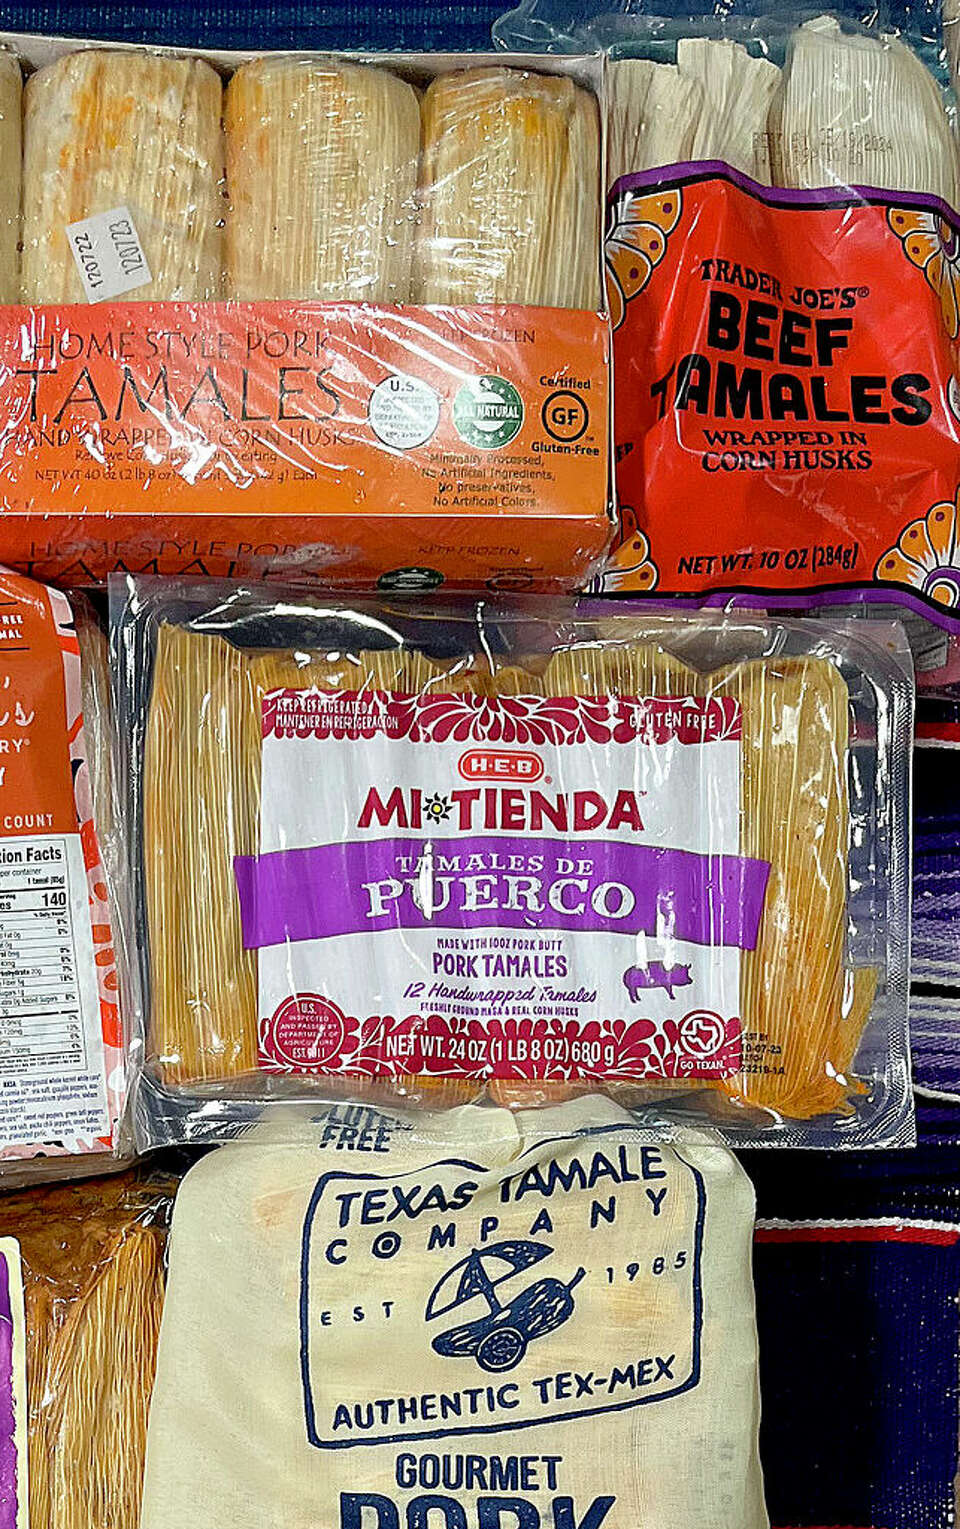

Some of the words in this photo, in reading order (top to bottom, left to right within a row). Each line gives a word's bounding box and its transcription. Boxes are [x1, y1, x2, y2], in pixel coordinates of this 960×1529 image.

[701, 259, 783, 300] TRADER
[789, 286, 858, 310] JOE'S
[707, 290, 853, 368] BEEF
[16, 367, 340, 425] TAMALES
[540, 376, 590, 389] Certified
[650, 353, 931, 427] TAMALES
[552, 408, 578, 424] GF
[532, 442, 599, 456] Gluten-Free
[702, 430, 833, 446] WRAPPED
[841, 432, 867, 446] IN
[702, 450, 779, 472] CORN
[783, 450, 872, 470] HUSKS
[358, 787, 421, 830] MI
[451, 789, 645, 832] TIENDA
[42, 892, 66, 907] 140
[363, 875, 636, 920] PUERCO
[433, 953, 477, 978] PORK
[482, 954, 567, 978] TAMALES
[335, 1182, 479, 1227] TEXAS
[332, 1383, 520, 1430] AUTHENTIC
[532, 1354, 675, 1404] TEX-MEX
[395, 1455, 562, 1492] GOURMET
